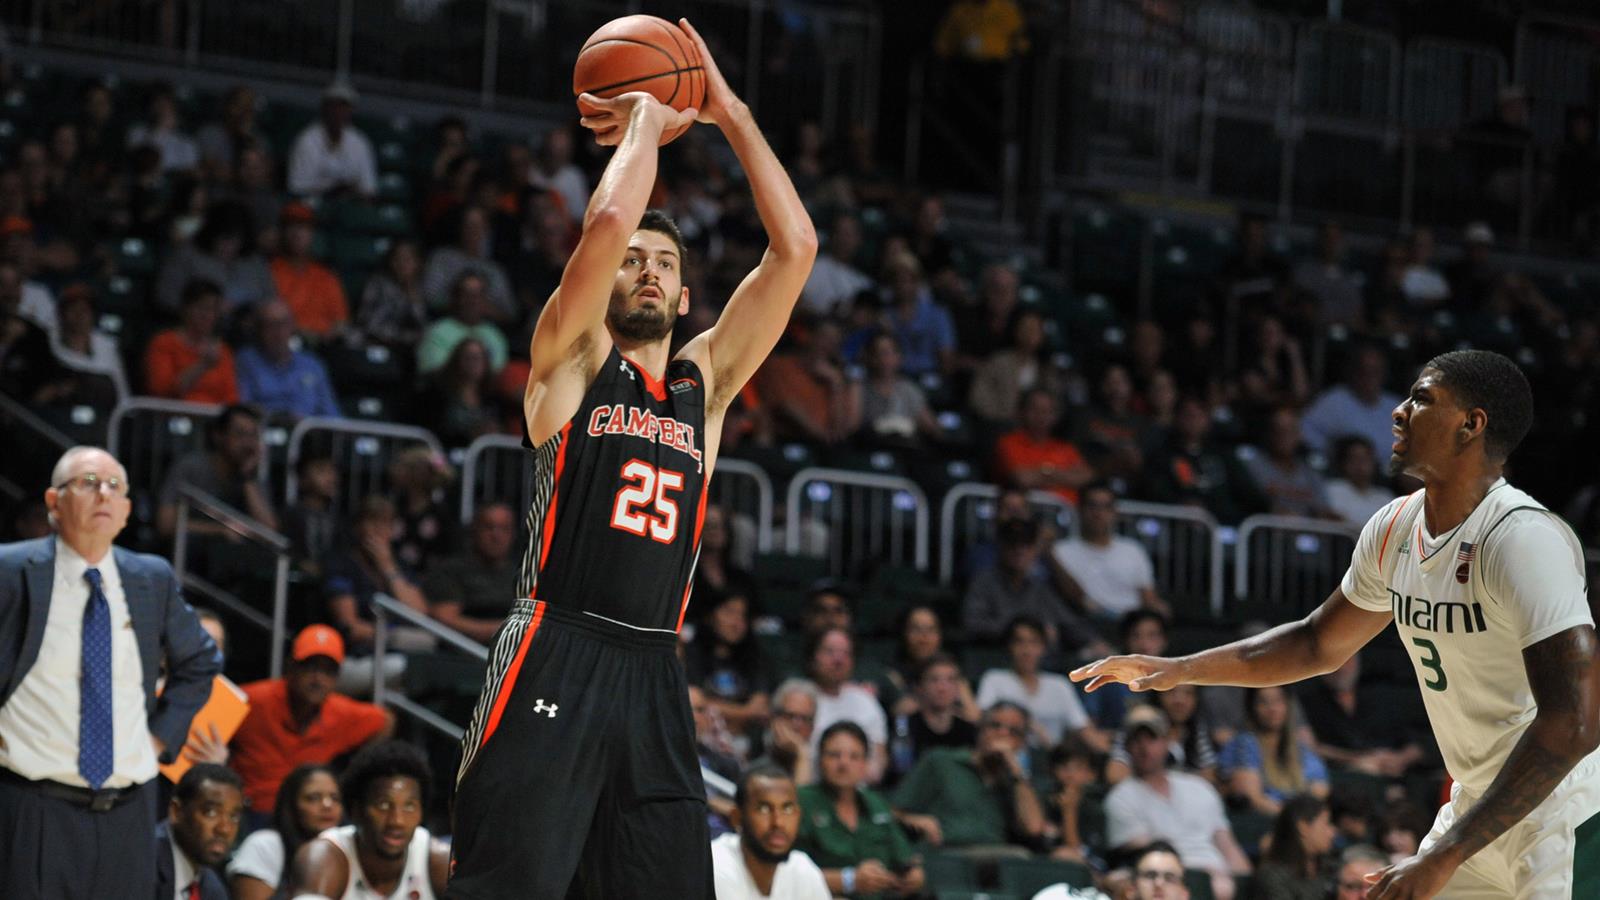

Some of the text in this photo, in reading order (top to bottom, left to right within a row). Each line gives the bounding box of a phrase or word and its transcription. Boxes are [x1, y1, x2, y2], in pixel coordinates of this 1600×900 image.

[587, 404, 702, 474] CAMPBEL
[610, 458, 684, 544] 25
[1412, 637, 1448, 692] 3
